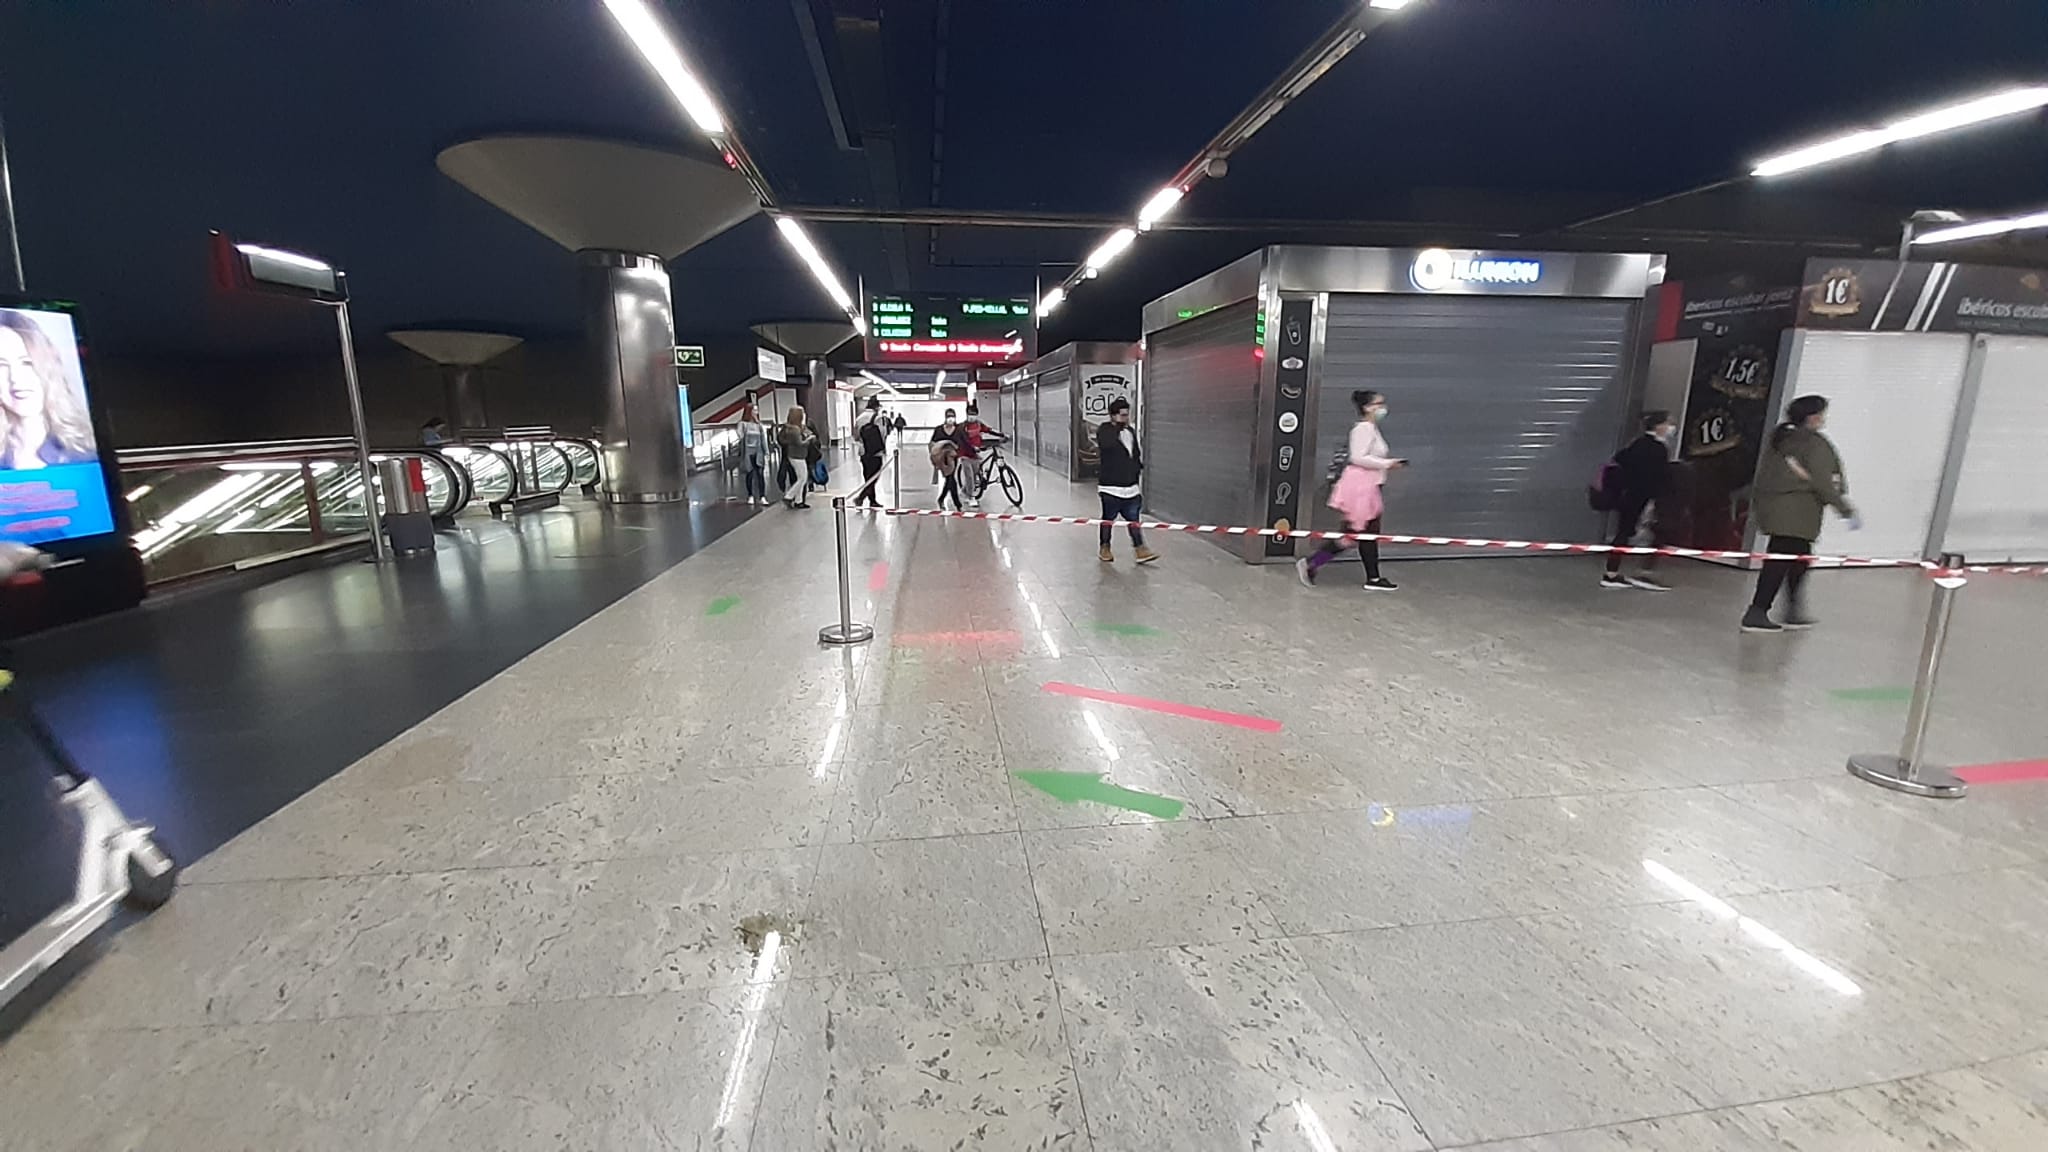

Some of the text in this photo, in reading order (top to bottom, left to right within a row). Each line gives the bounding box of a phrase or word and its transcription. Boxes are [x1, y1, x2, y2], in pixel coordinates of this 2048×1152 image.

[1824, 277, 1849, 305] 1€
[1724, 356, 1760, 385] 1,5€
[1700, 416, 1724, 444] 1€
